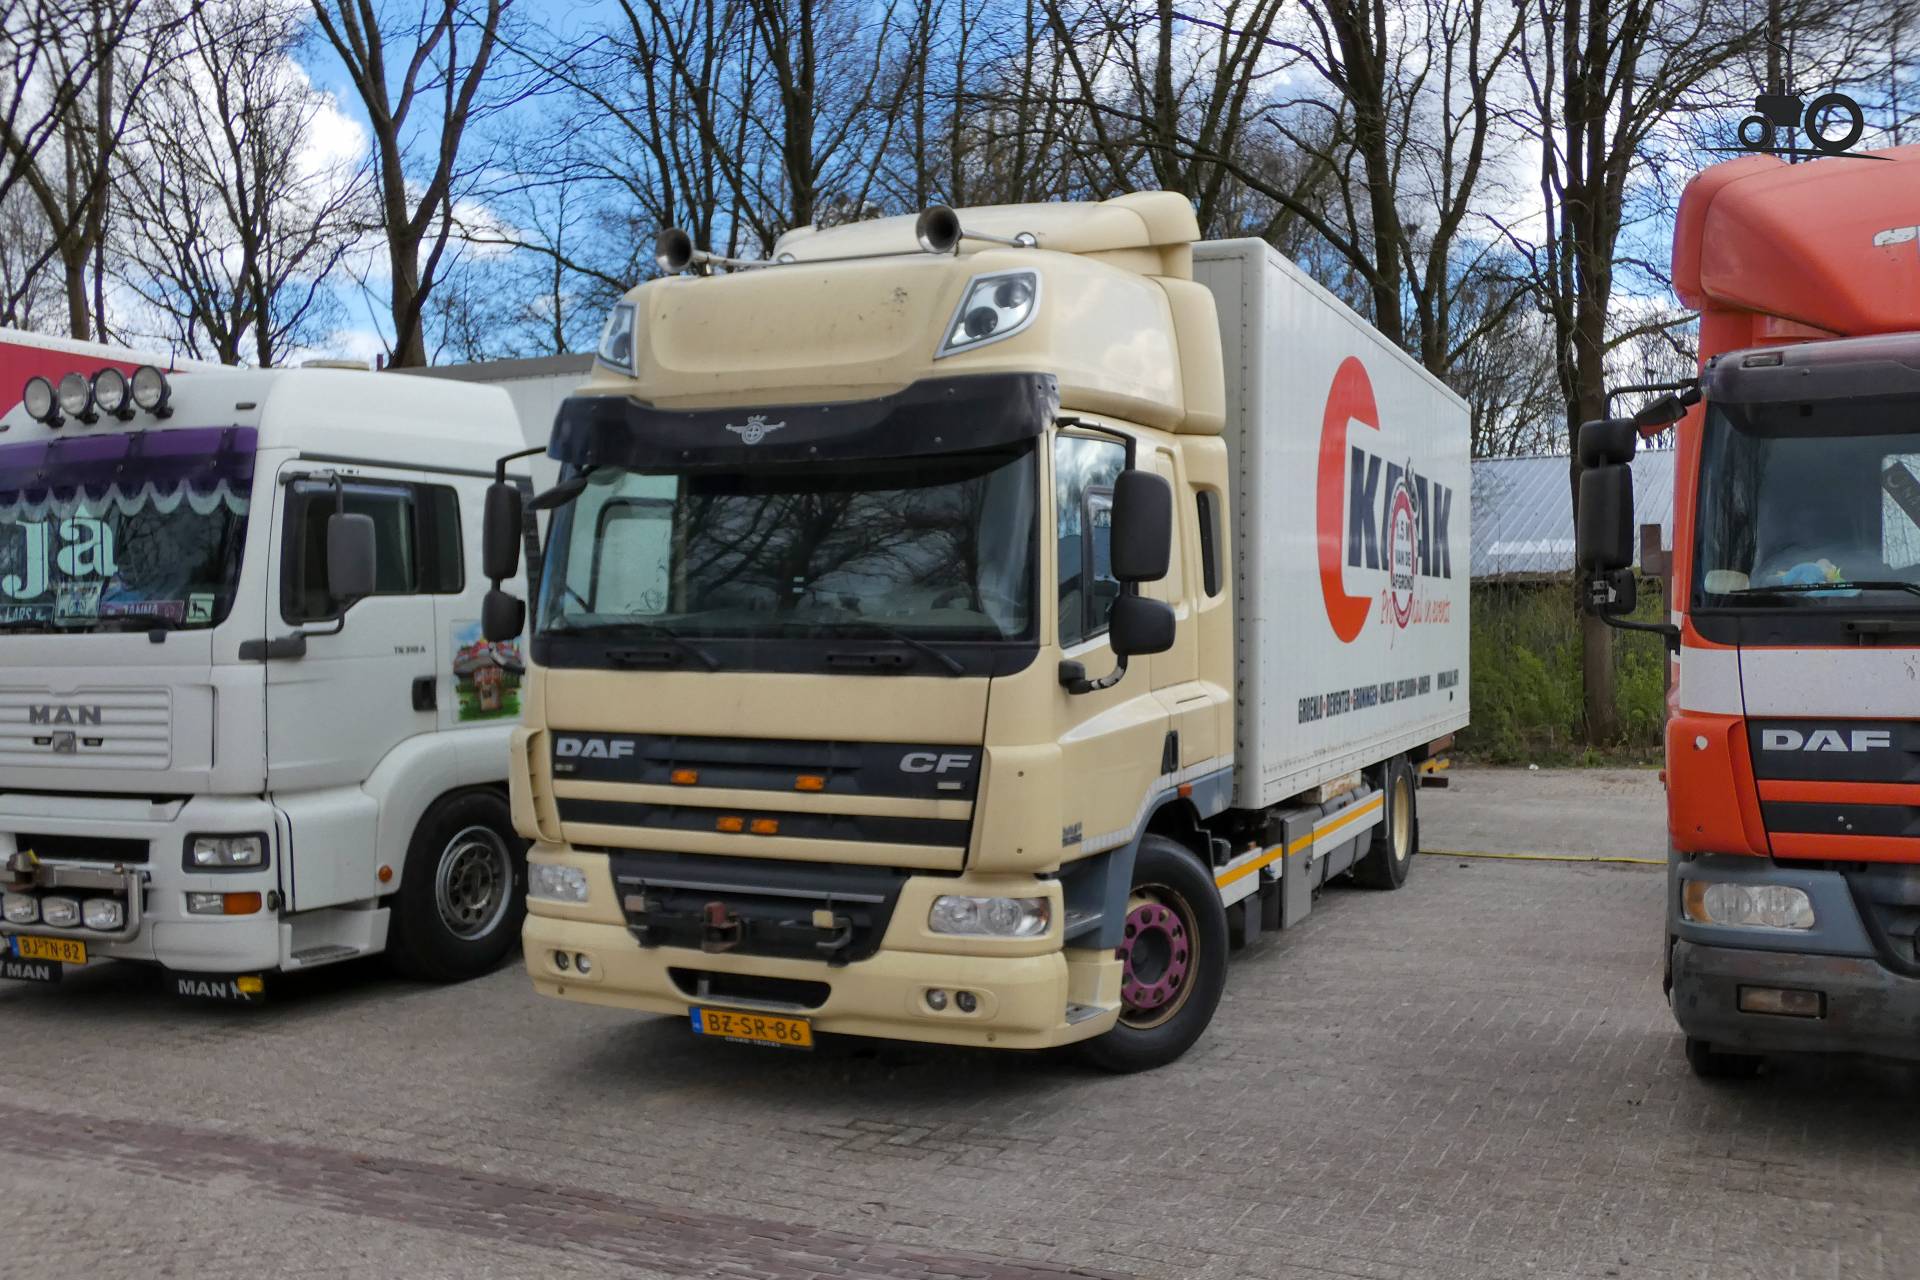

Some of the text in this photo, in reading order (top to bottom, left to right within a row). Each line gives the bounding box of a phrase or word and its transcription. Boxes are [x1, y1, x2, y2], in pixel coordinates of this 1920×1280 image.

[2, 516, 118, 600] Ja
[29, 704, 102, 726] MAN
[555, 736, 635, 760] DAF
[1762, 729, 1890, 752] DAF
[899, 752, 973, 774] CF
[7, 962, 50, 980] MAN
[178, 979, 227, 998] MAN
[707, 1013, 801, 1041] BZ-SR-86
